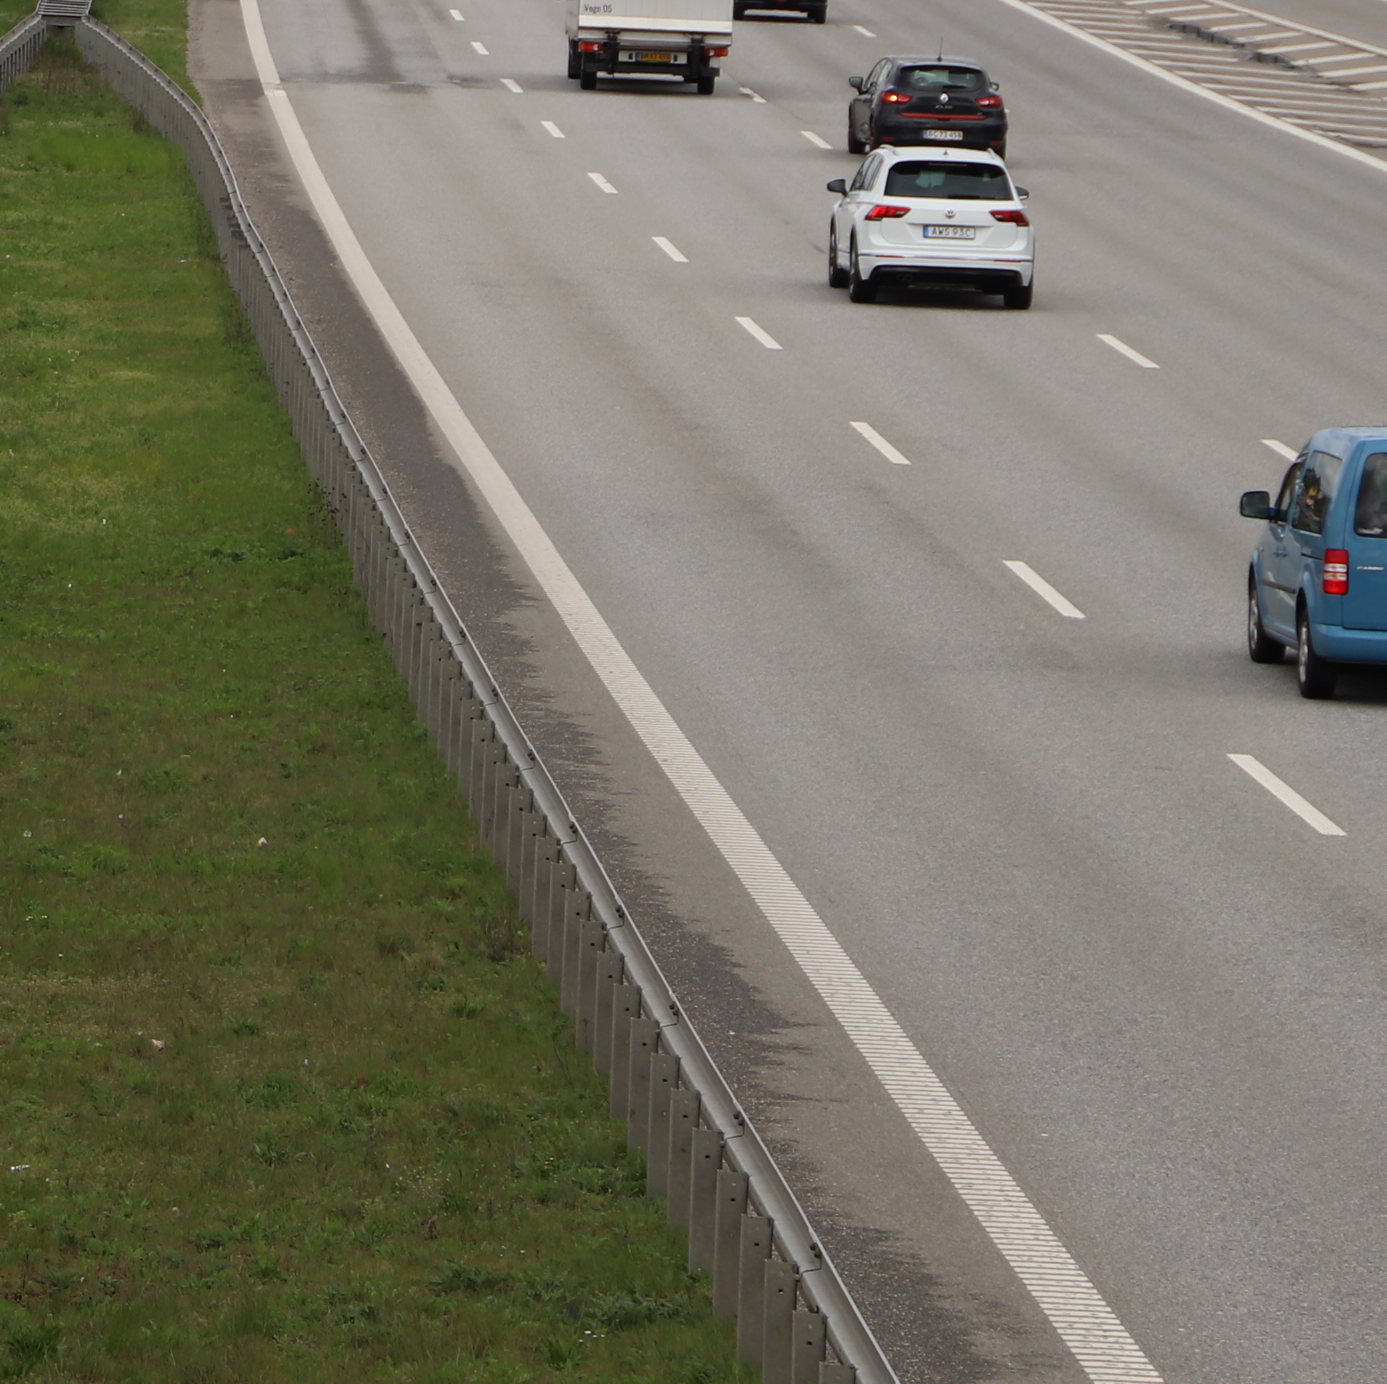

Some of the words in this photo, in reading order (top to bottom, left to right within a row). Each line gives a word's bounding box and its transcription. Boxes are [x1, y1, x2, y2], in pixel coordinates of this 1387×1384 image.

[584, 4, 601, 14] Vogn
[931, 227, 950, 236] AWS
[953, 228, 971, 237] 93C
